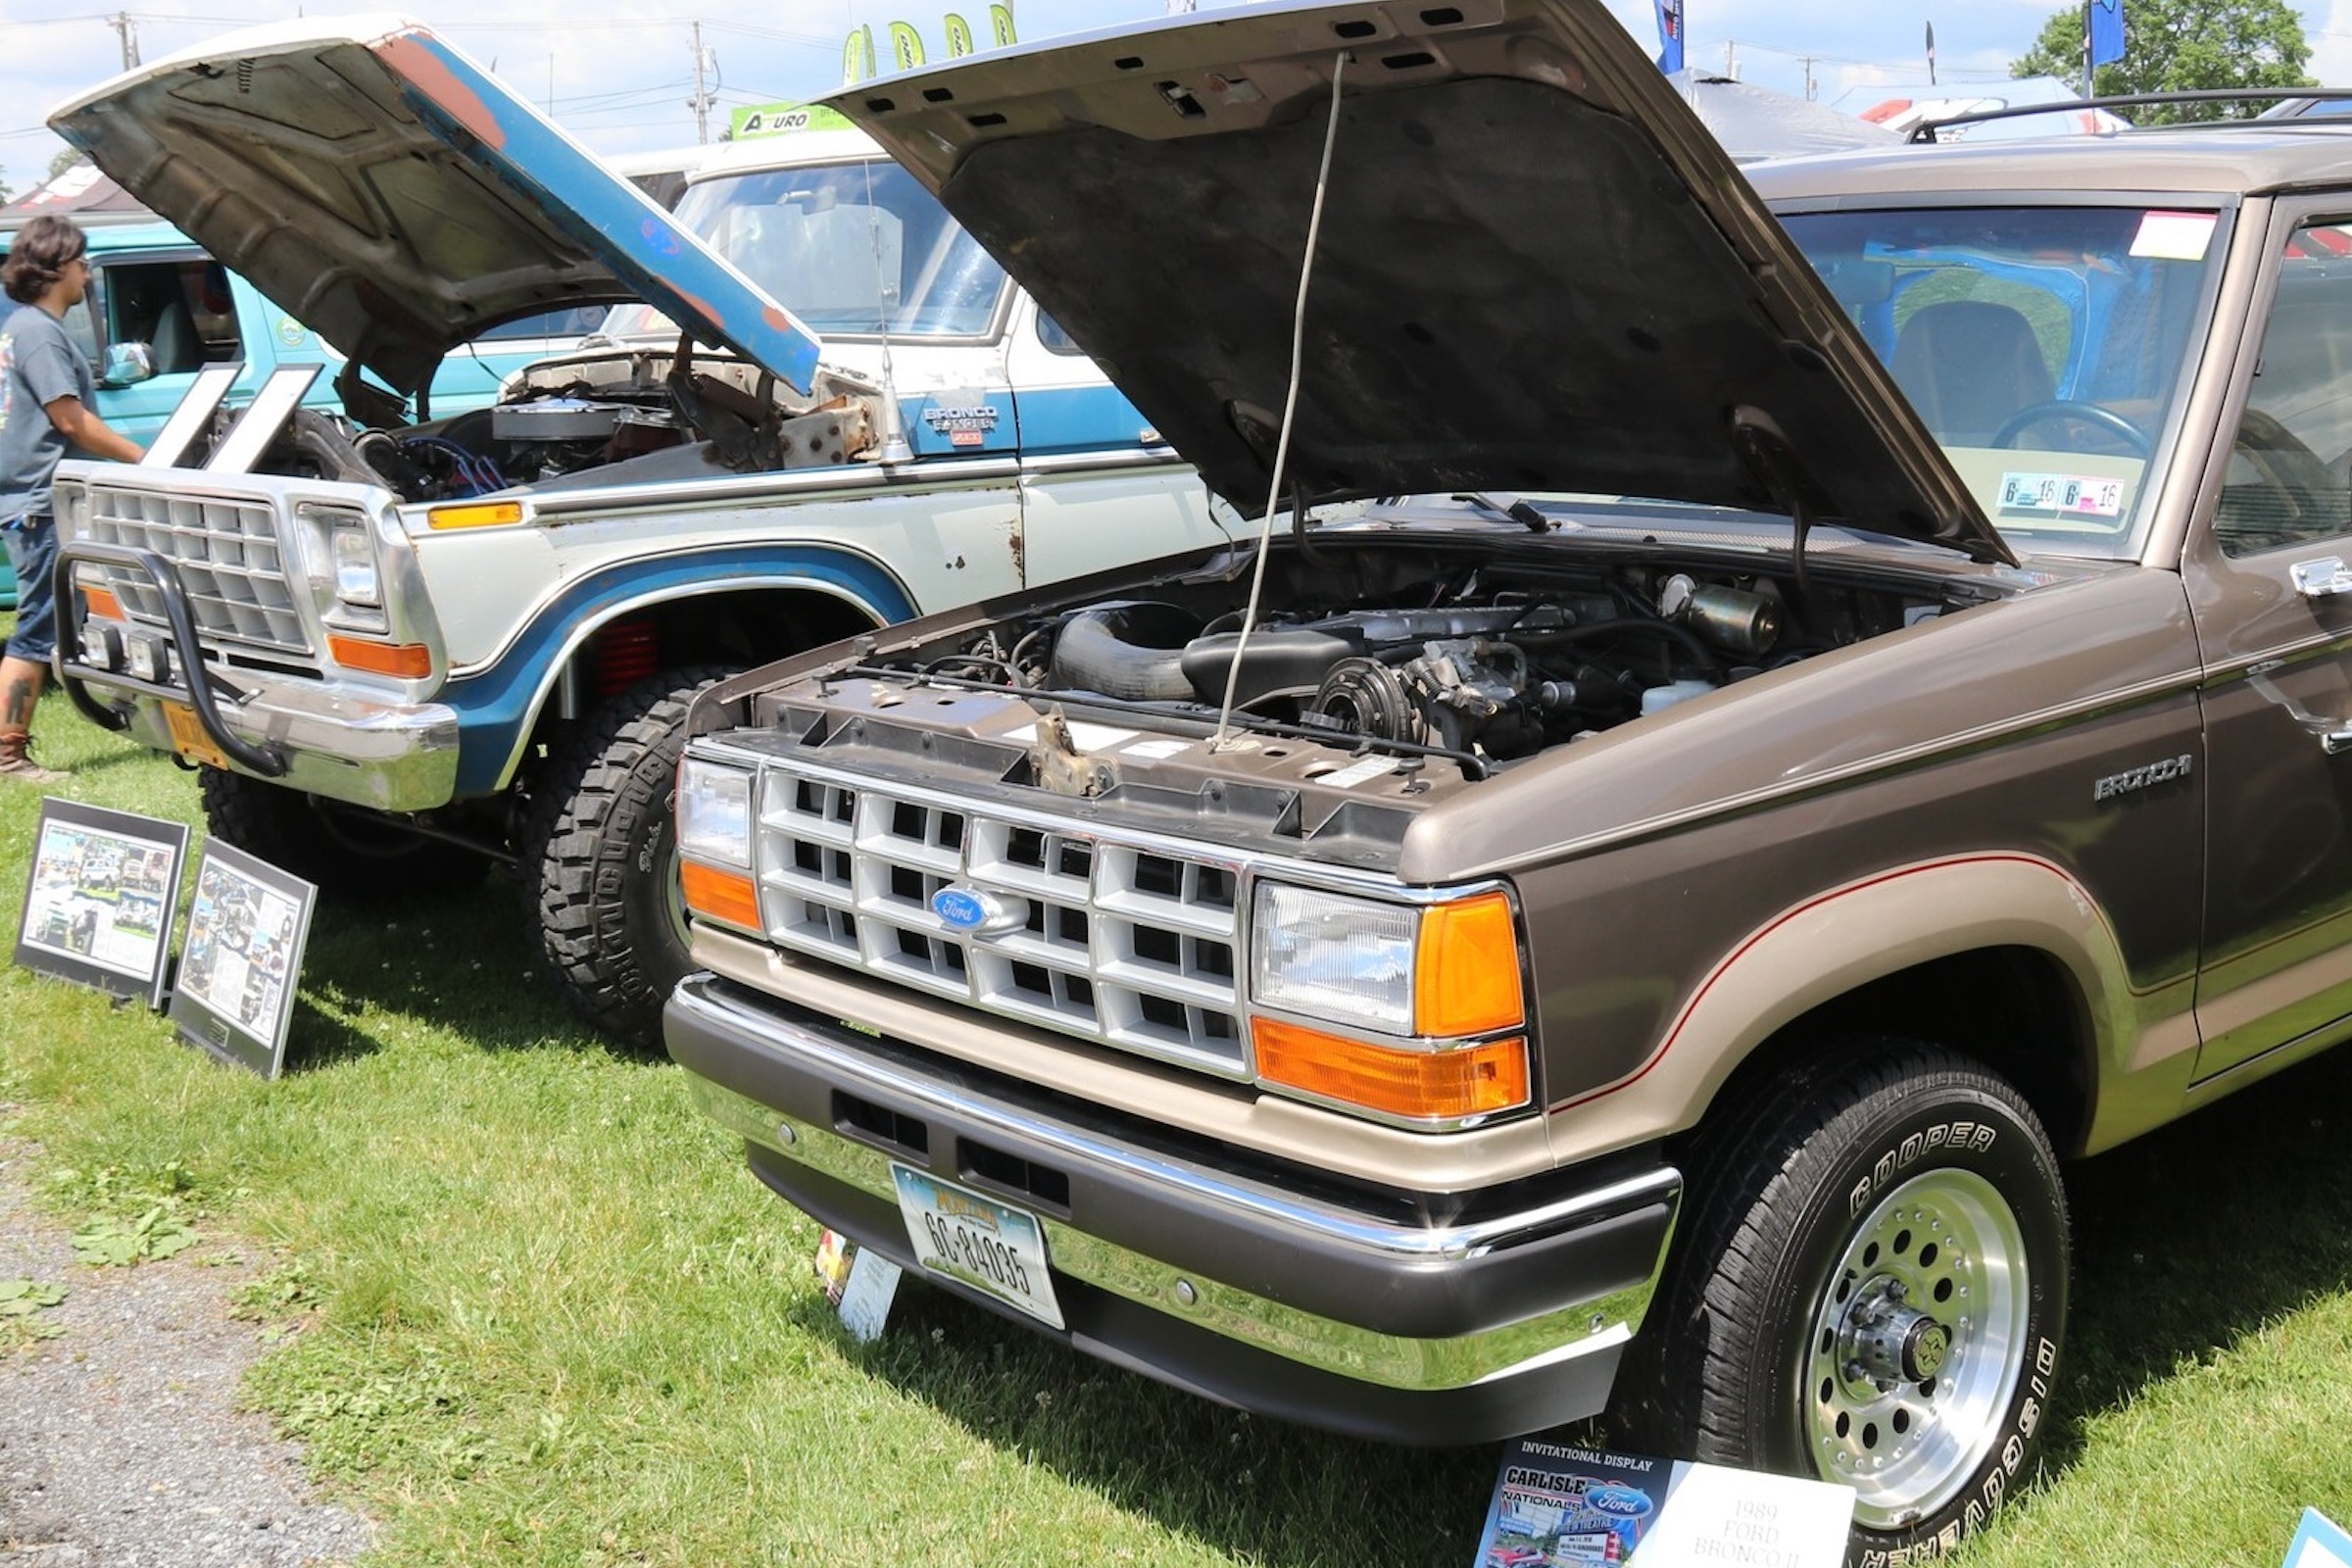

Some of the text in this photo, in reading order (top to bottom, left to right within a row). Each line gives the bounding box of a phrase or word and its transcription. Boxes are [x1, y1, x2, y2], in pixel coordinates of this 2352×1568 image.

[743, 114, 808, 132] AURO
[924, 406, 999, 420] BRONCO
[932, 417, 996, 431] RANGER
[2005, 479, 2055, 503] 6 16
[2065, 484, 2117, 507] 6 16
[2094, 759, 2177, 801] BRONCO
[942, 894, 974, 922] Ford
[1850, 1122, 1996, 1220] COOPER
[925, 1211, 1031, 1296] 6C-84035
[1522, 1441, 1653, 1472] INVITATIONAL DISPLAY
[1506, 1466, 1587, 1494] CARLISLE
[1501, 1491, 1583, 1512] NATIONALS
[1597, 1490, 1638, 1513] Ford
[1736, 1499, 1779, 1522] 1989
[1724, 1519, 1780, 1544] FORD
[1694, 1537, 1781, 1568] BRONCO
